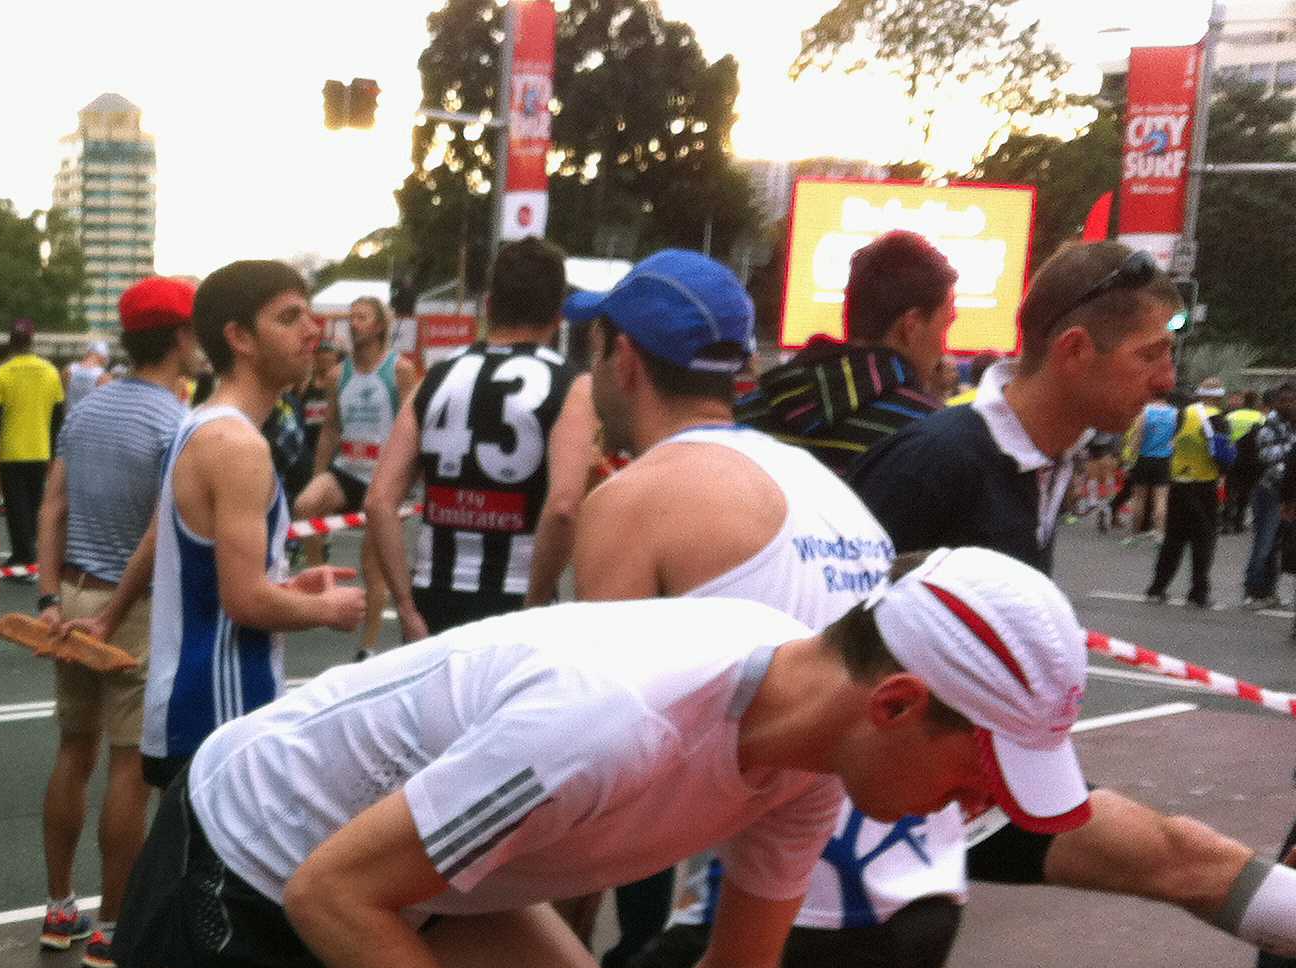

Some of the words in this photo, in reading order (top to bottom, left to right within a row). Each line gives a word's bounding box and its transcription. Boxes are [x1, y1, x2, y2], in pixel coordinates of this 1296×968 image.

[1122, 149, 1187, 180] SURF
[421, 353, 553, 484] 43
[428, 502, 525, 528] Emirates
